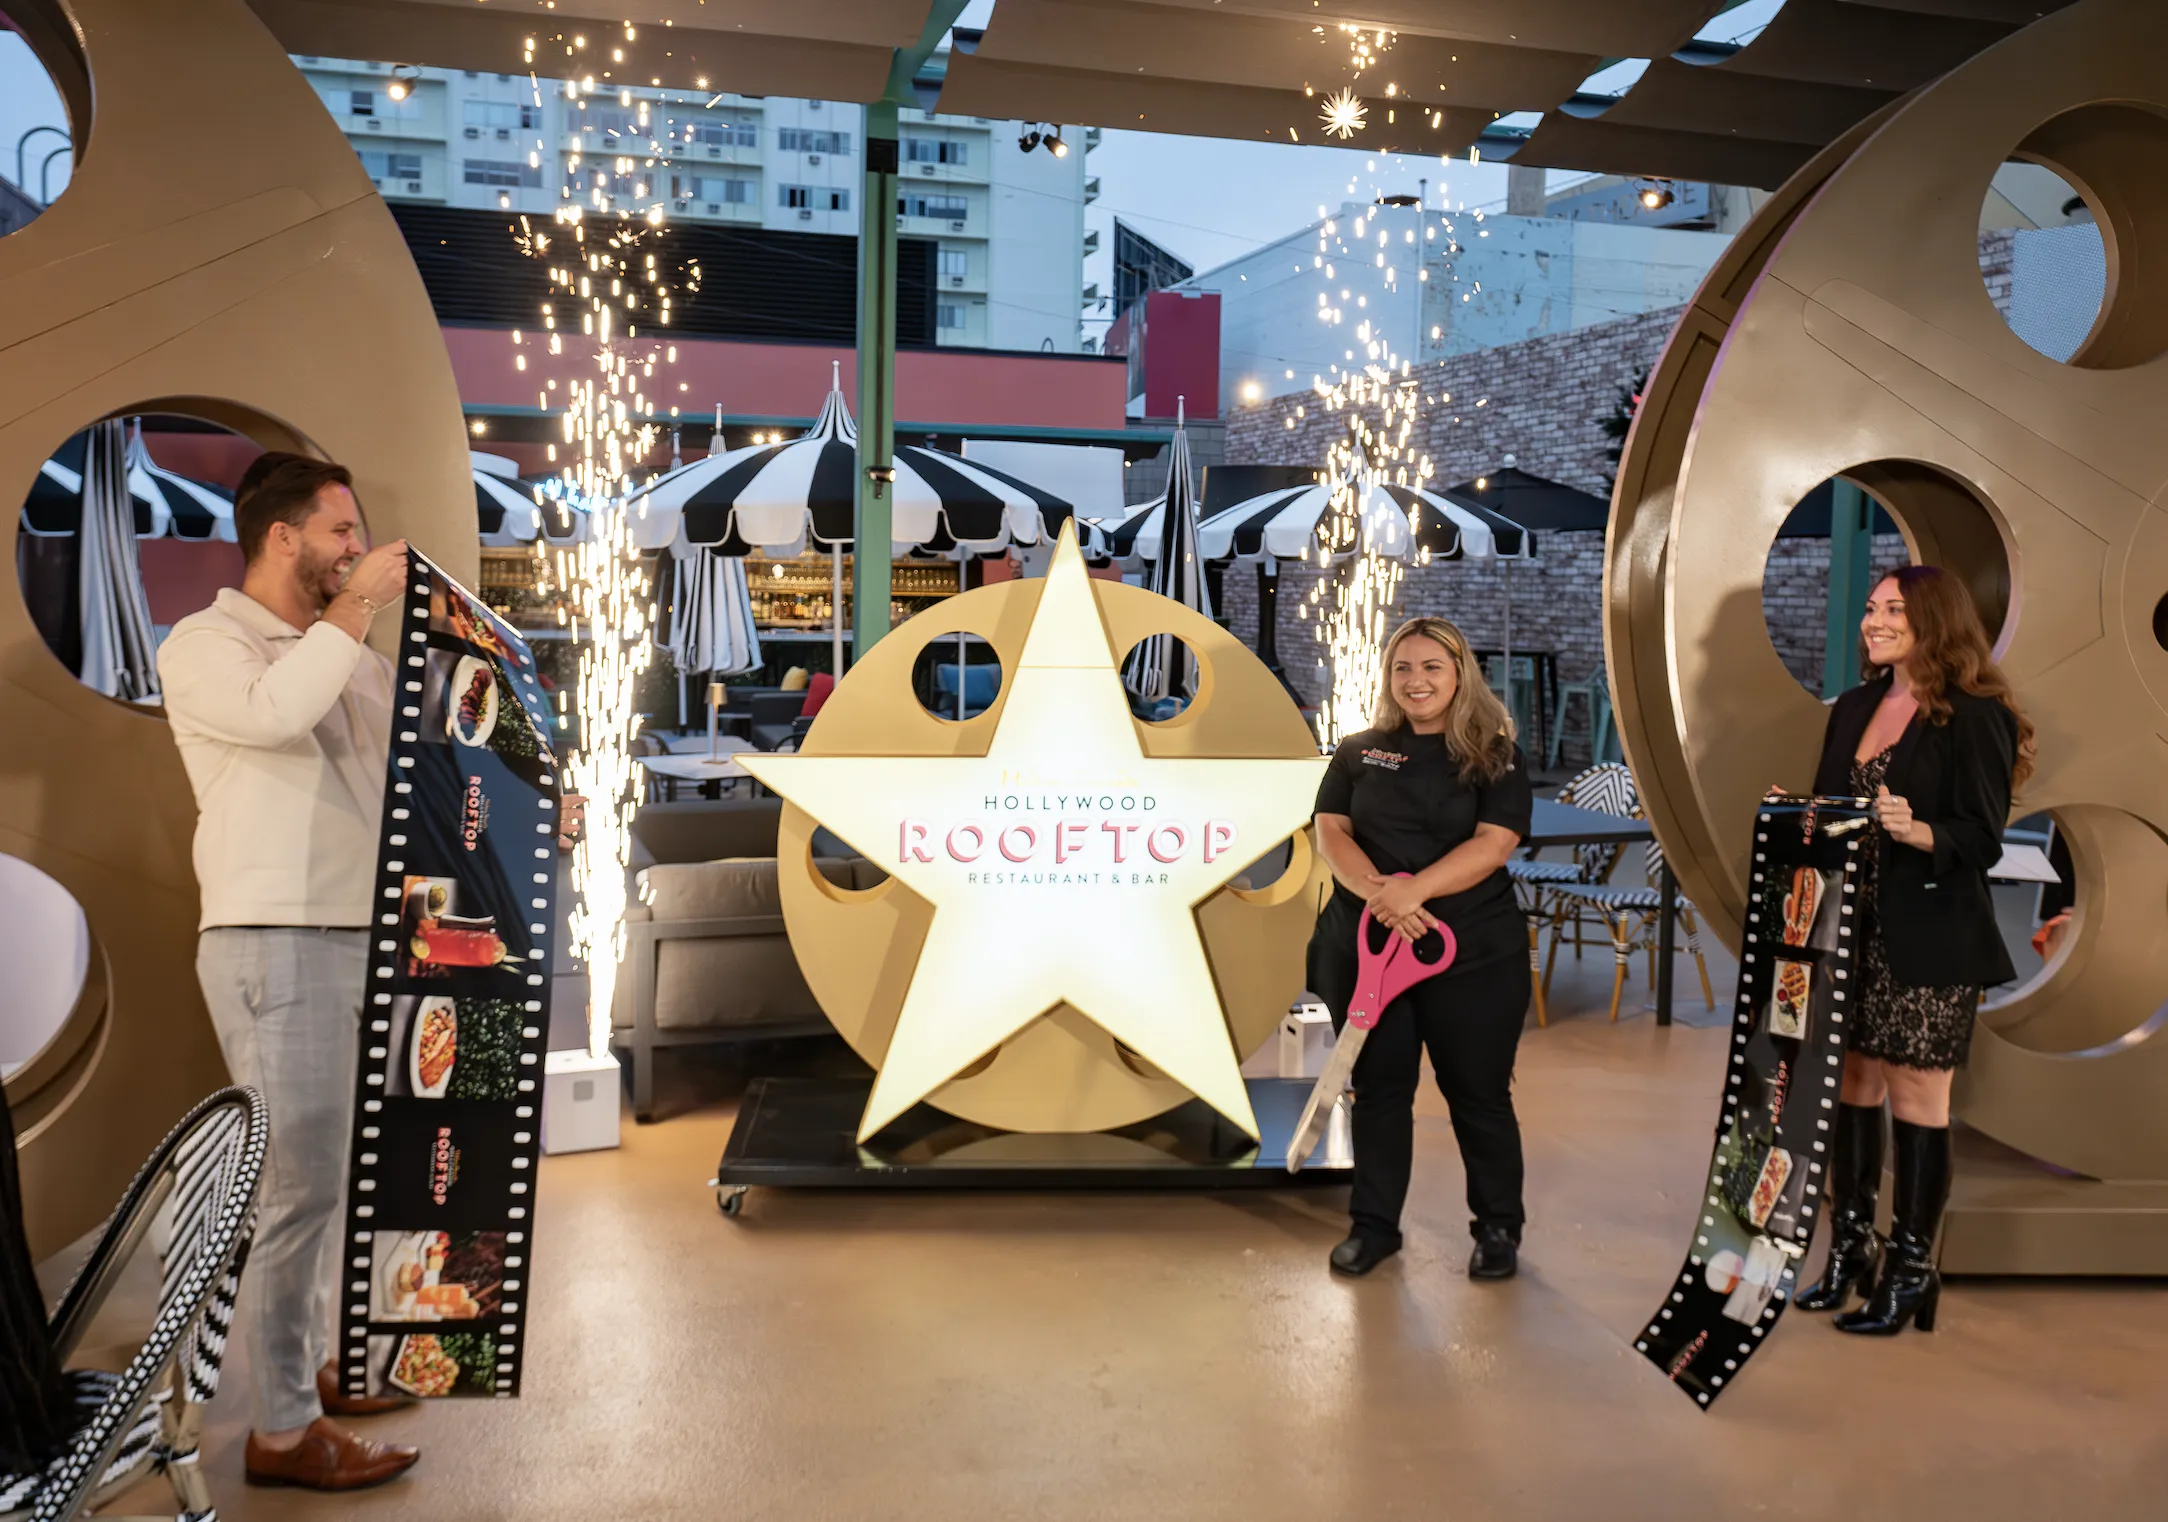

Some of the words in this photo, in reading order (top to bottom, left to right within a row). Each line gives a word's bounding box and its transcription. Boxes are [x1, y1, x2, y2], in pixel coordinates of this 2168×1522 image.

[463, 775, 482, 852] ROOFTOP
[984, 795, 1157, 811] HOLLYWOOD
[899, 817, 1239, 864] ROOFTOP
[968, 873, 1100, 885] RESTAURANT
[1111, 873, 1120, 884] &
[1131, 873, 1169, 885] BAR
[432, 1127, 451, 1206] ROOFTOP
